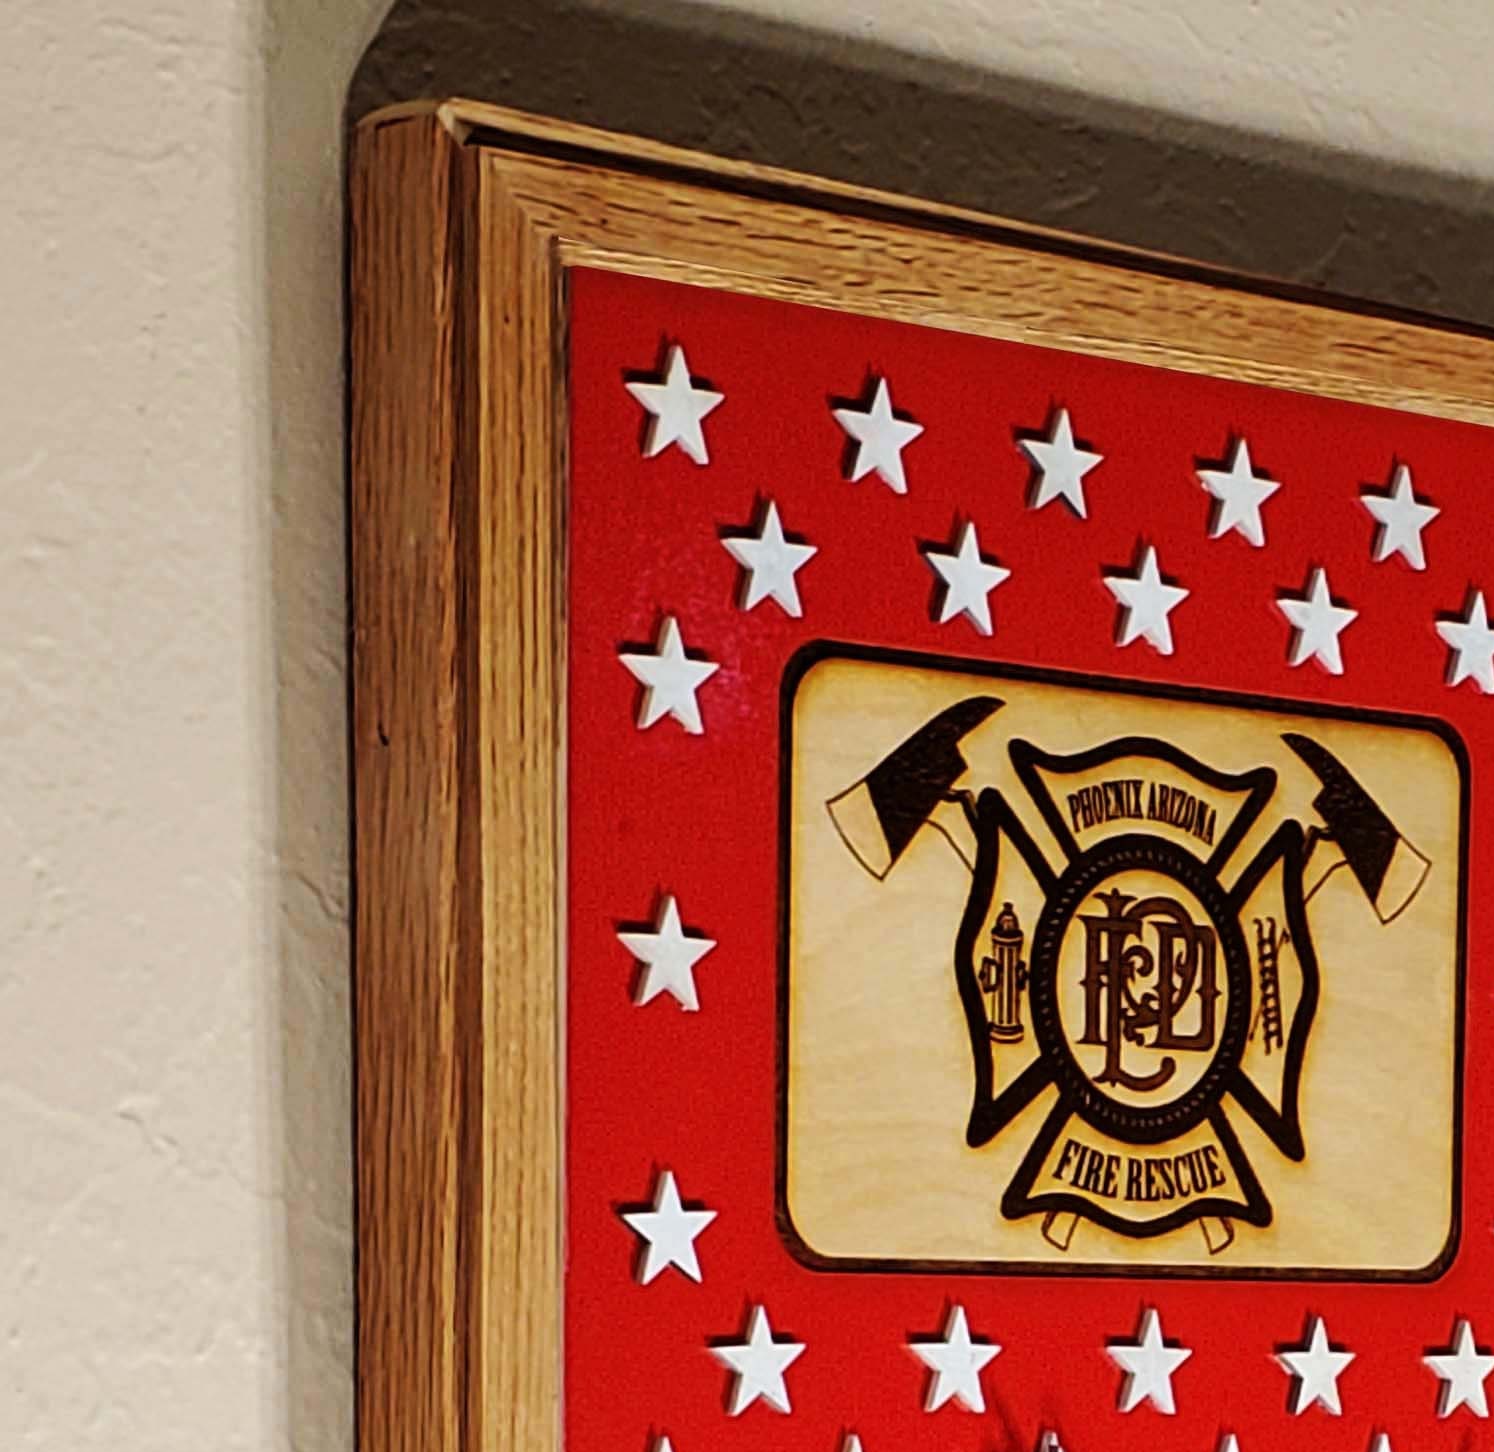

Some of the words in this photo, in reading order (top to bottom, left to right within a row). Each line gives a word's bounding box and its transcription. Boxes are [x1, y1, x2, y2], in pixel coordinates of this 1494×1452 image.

[1067, 780, 1144, 833] PHOENIX
[1147, 782, 1217, 846] ARIZONA
[1052, 1138, 1121, 1198] FIRE
[1124, 1144, 1226, 1201] RESCUE
